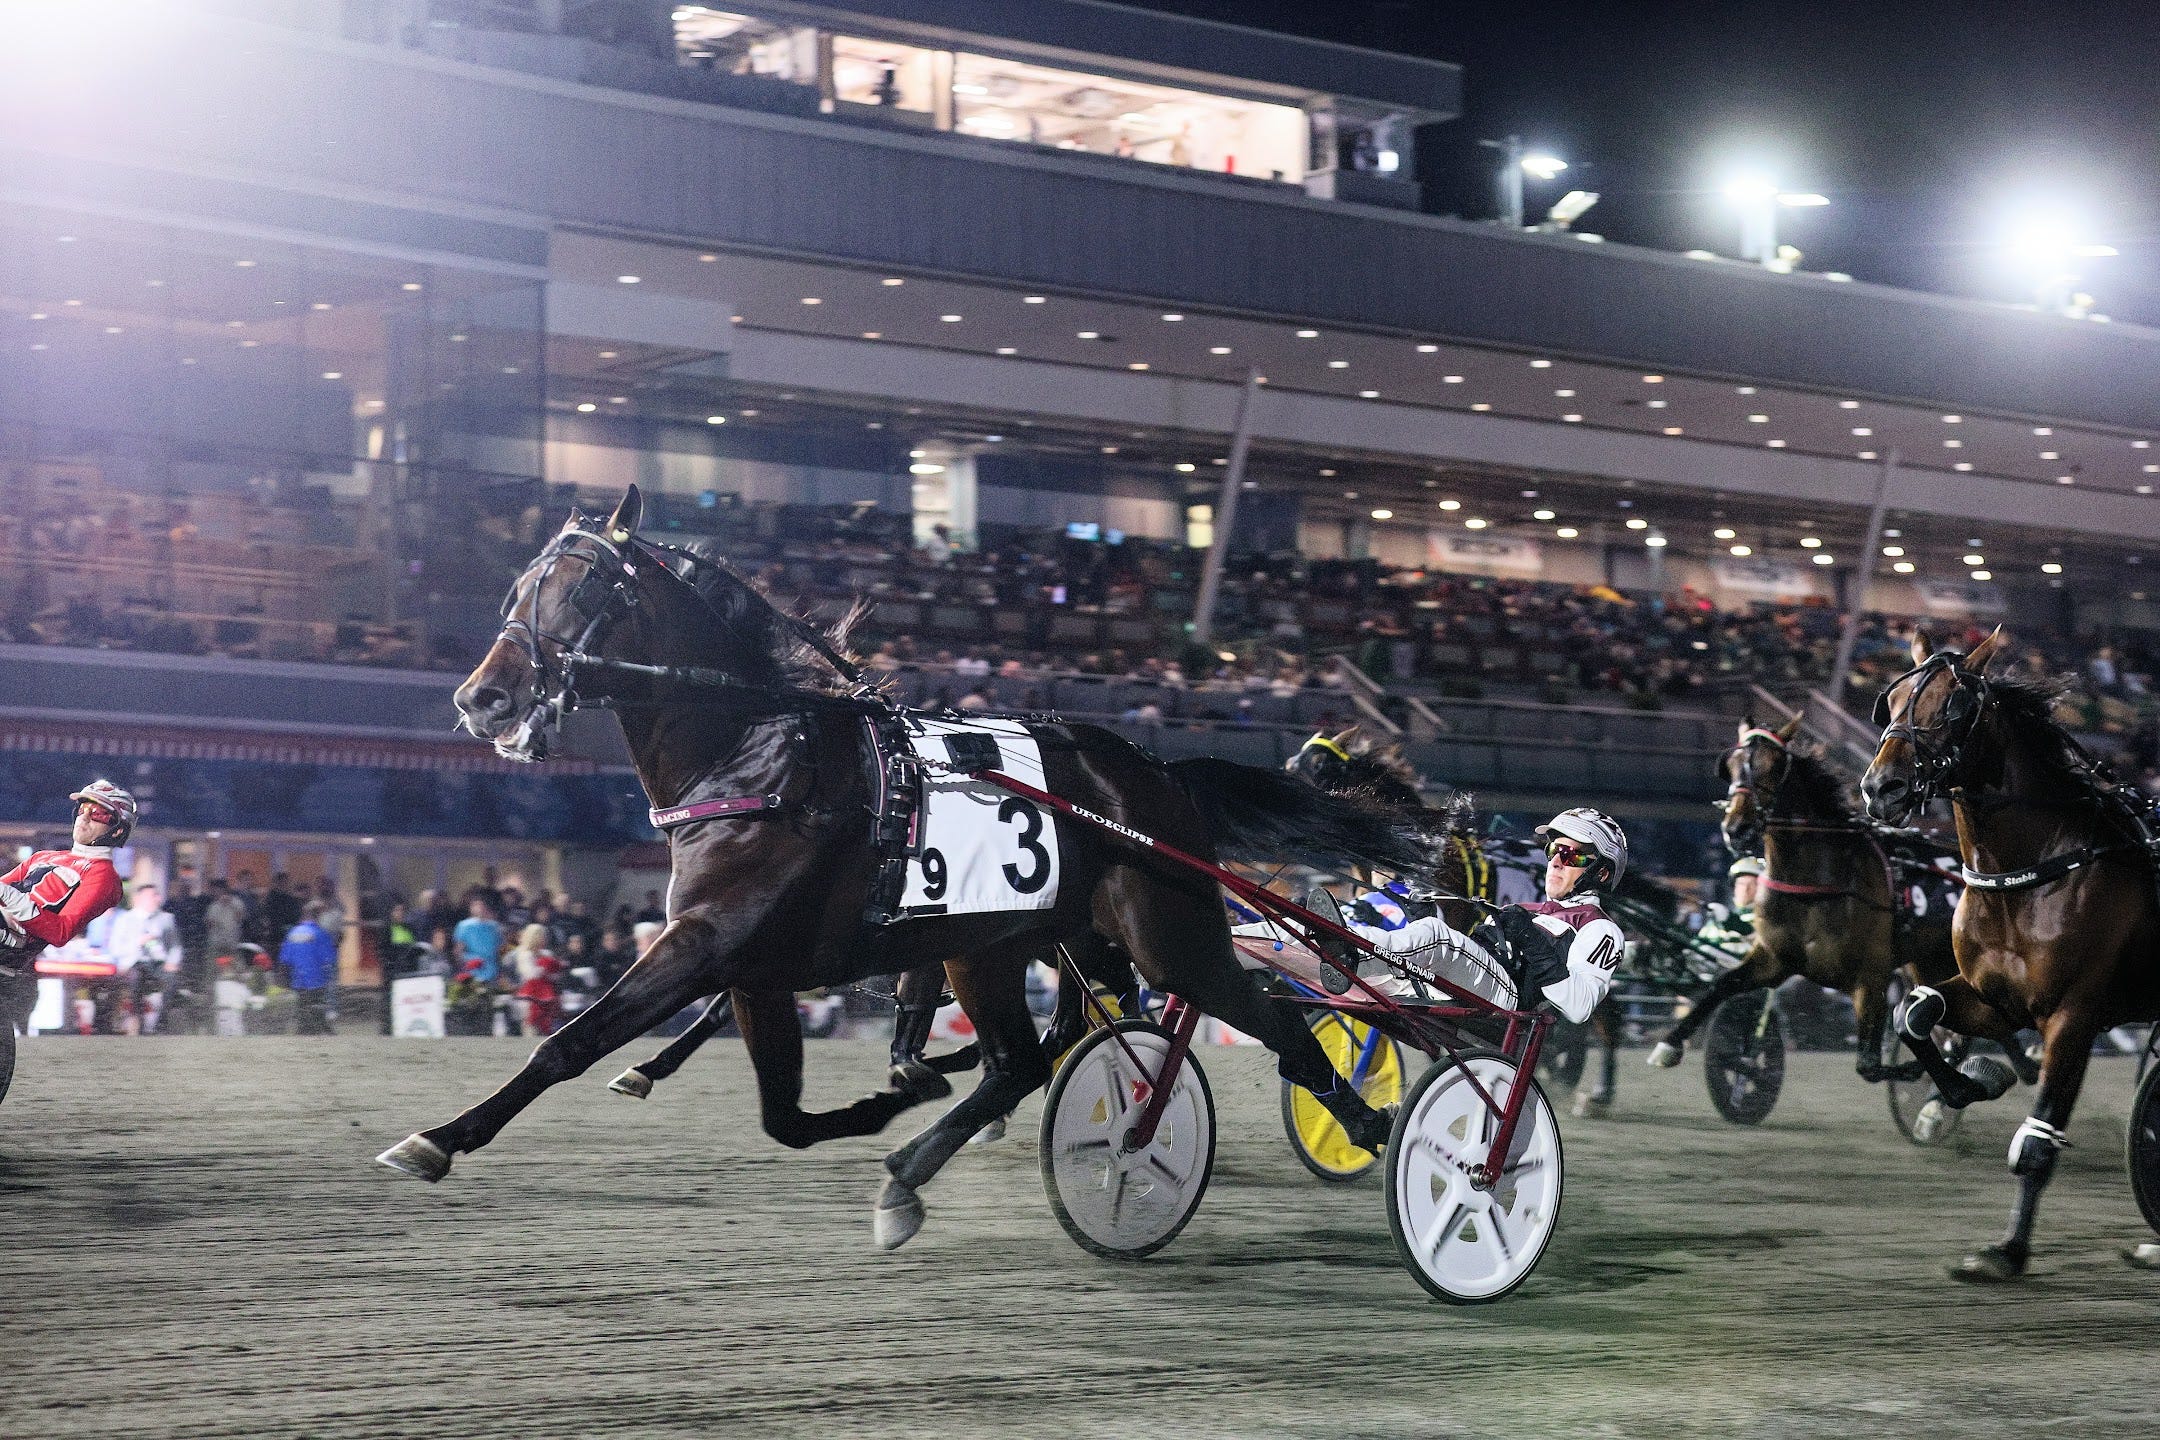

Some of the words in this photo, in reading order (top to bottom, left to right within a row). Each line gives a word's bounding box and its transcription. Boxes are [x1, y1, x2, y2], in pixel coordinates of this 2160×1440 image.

[657, 809, 691, 826] RACING
[998, 797, 1051, 894] 3
[921, 847, 947, 900] 9
[2003, 872, 2038, 886] Stable
[1373, 944, 1403, 966] GREGG
